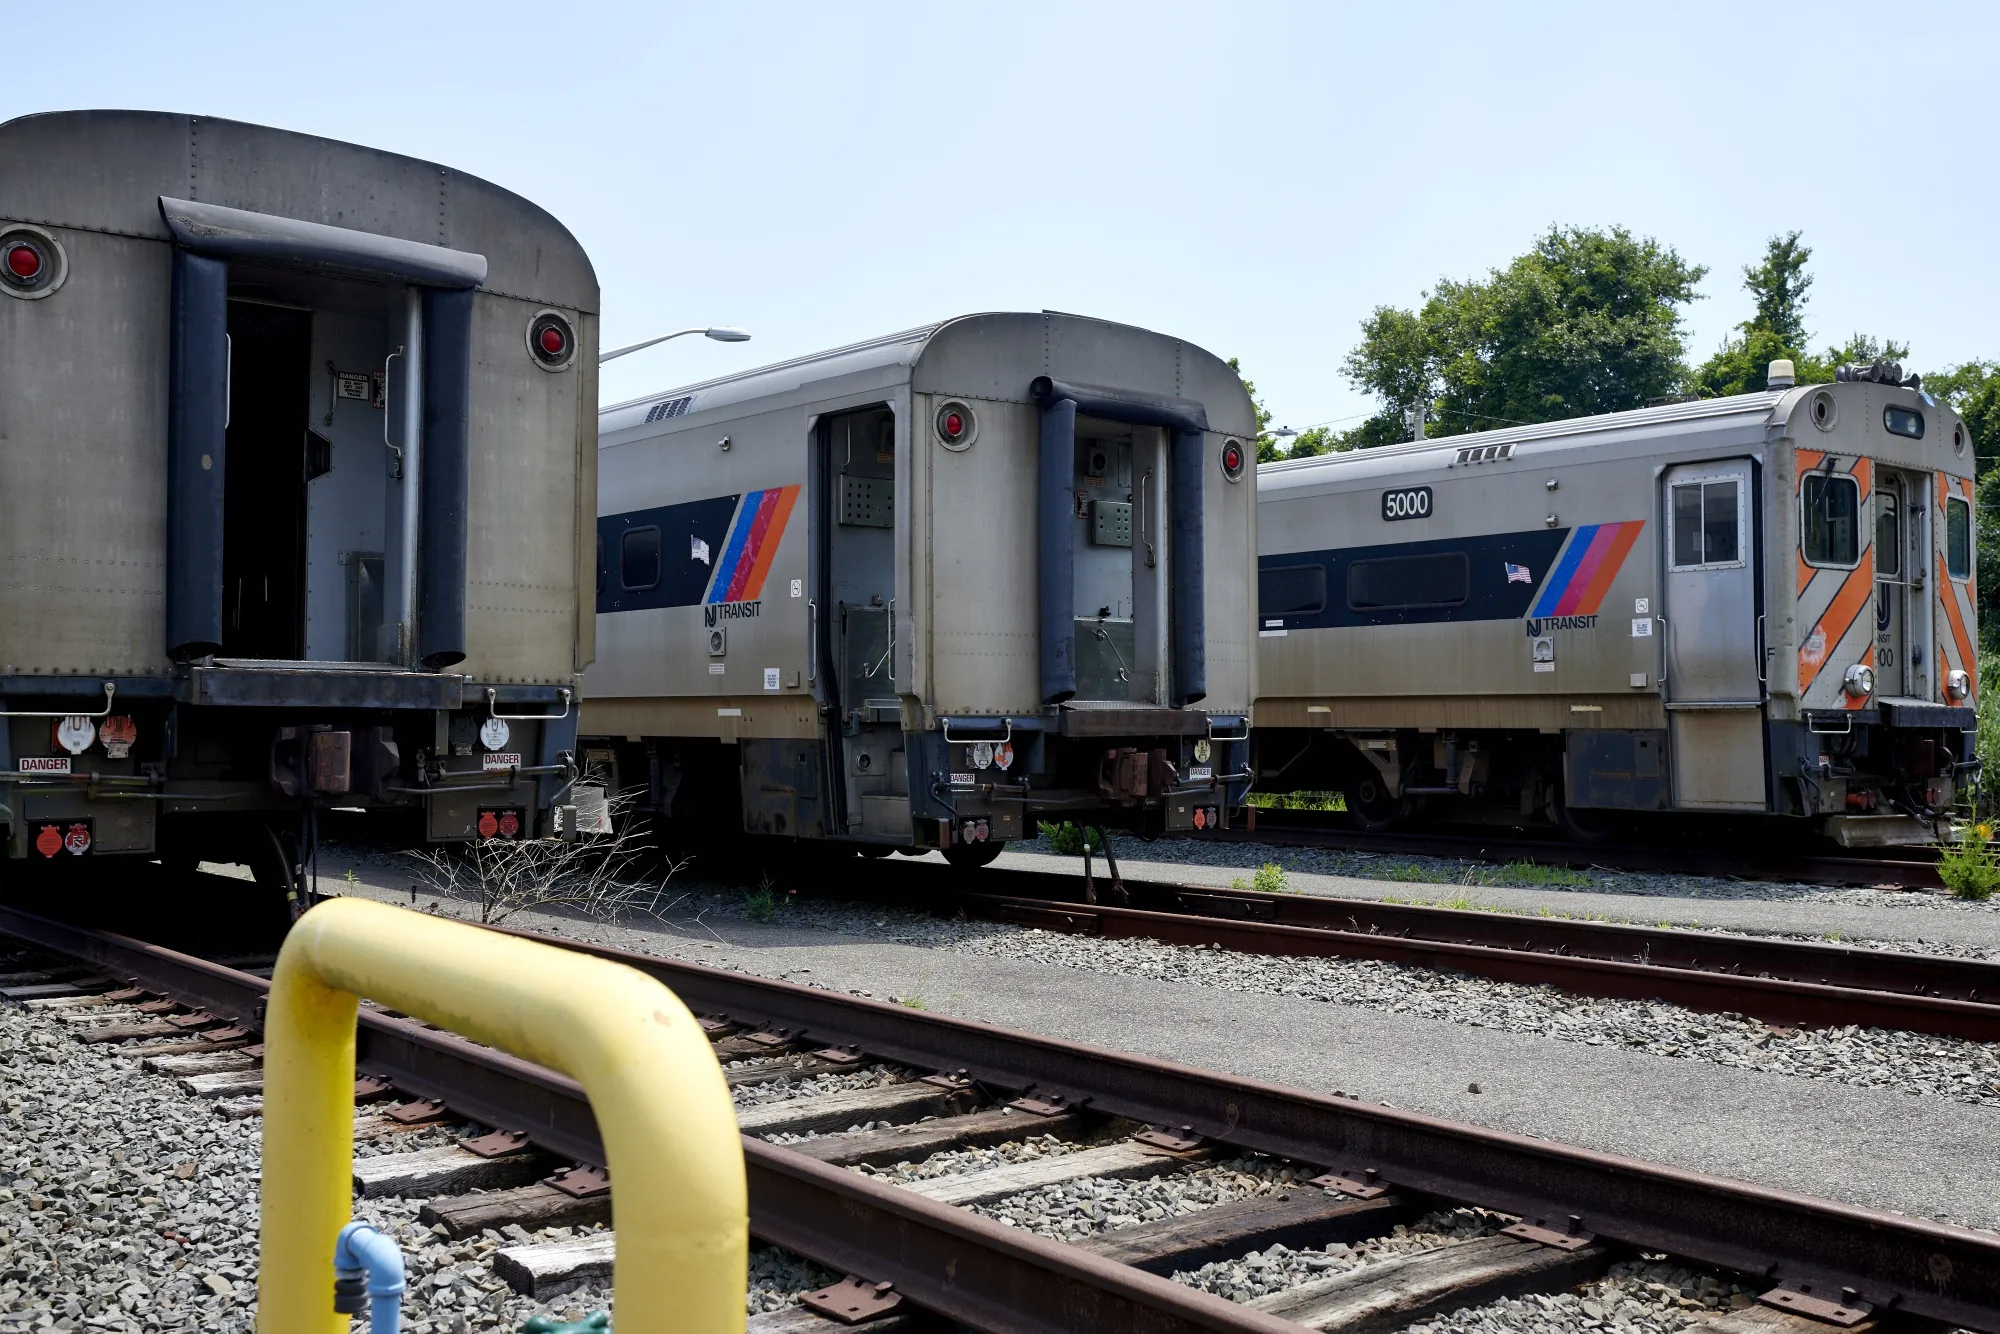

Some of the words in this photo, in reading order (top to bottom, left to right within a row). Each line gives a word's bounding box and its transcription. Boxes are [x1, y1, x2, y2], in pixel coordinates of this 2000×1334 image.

[340, 373, 368, 381] DANGER
[1386, 490, 1428, 517] 5000
[1877, 582, 1891, 632] J
[704, 604, 717, 628] NJ
[717, 601, 762, 620] TRANSIT
[1526, 618, 1542, 637] NJ
[1542, 615, 1598, 631] TRANSIT
[1767, 647, 1775, 661] F
[21, 758, 68, 771] DANGER
[485, 754, 519, 764] DANGER
[950, 774, 974, 783] DANGER
[1190, 768, 1210, 776] DANGER
[72, 835, 84, 848] R
